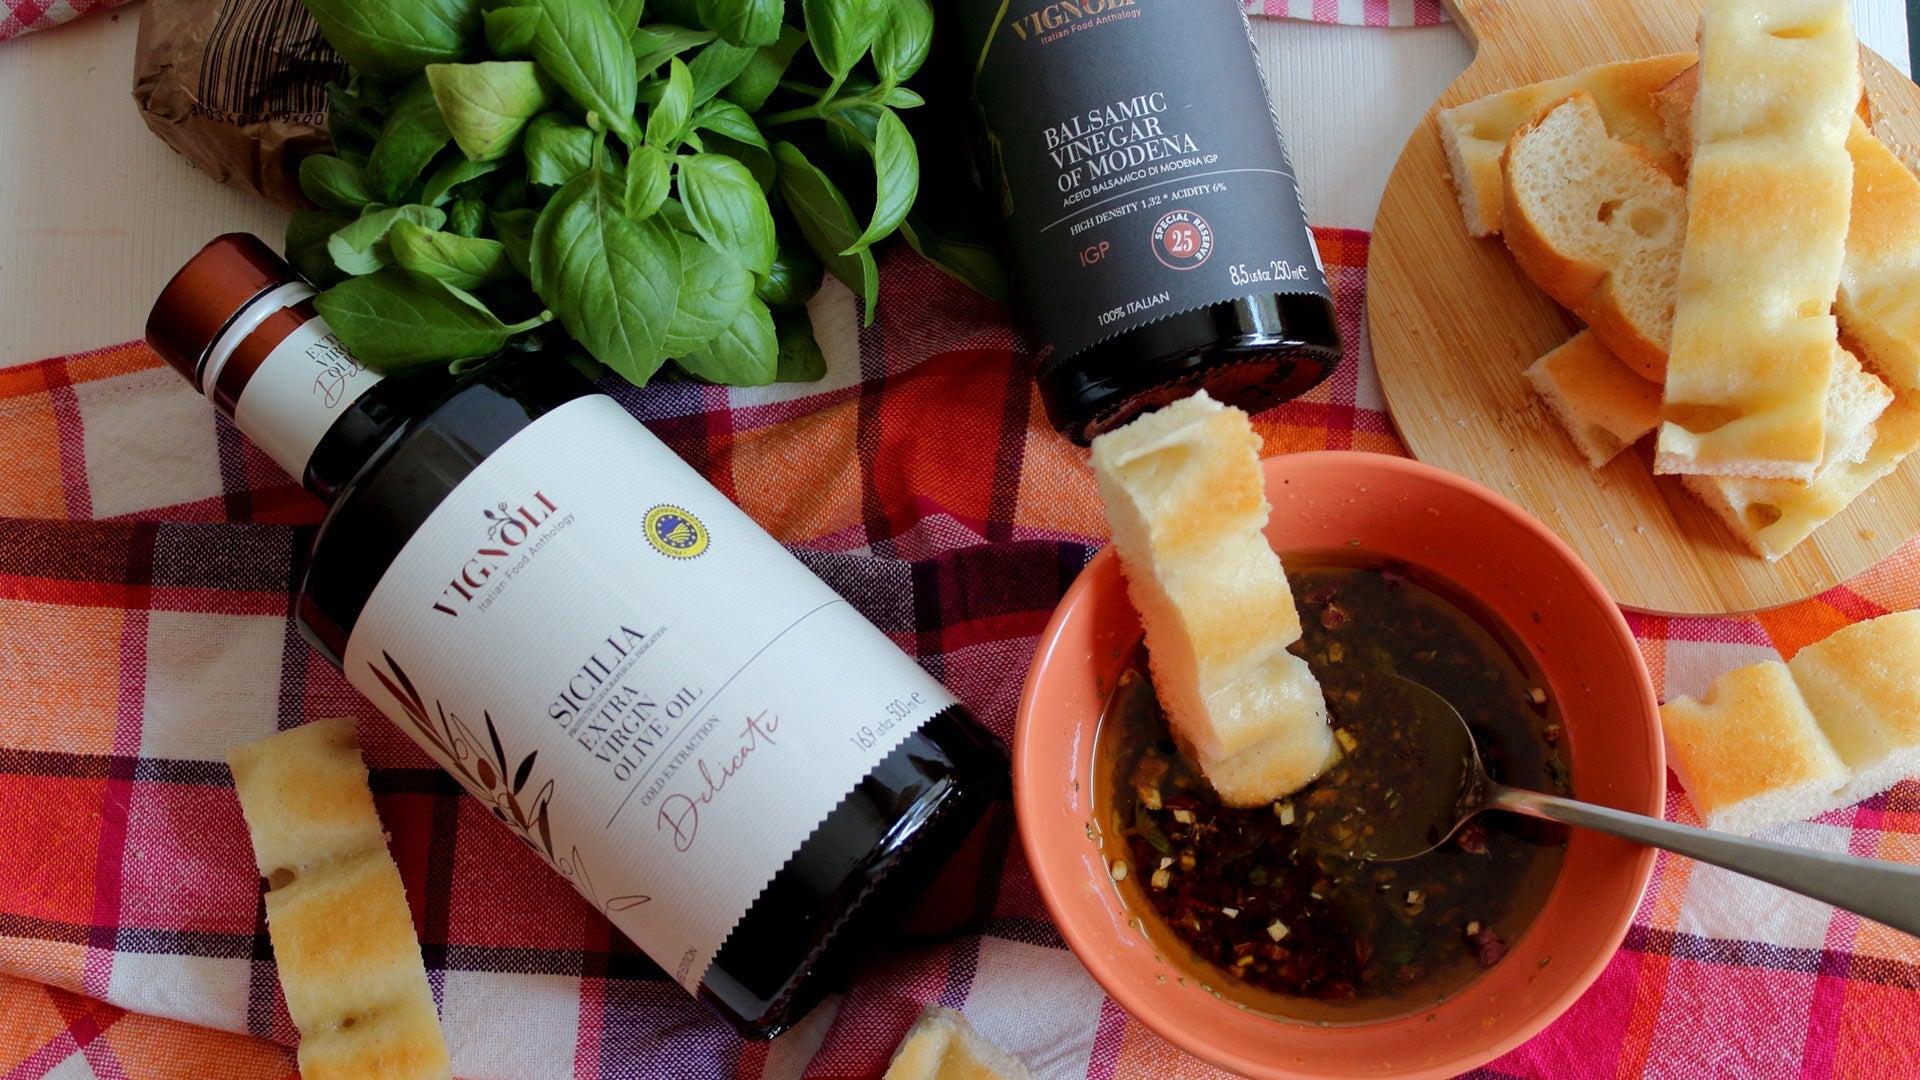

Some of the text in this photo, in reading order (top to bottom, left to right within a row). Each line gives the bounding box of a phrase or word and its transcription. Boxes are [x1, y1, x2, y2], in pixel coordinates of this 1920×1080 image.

[1011, 0, 1136, 41] VIGNO
[1041, 8, 1141, 45] Italian Food Anthology
[1043, 92, 1167, 150] BALSAMIC
[1050, 116, 1164, 170] VINEGAR
[1058, 133, 1200, 193] OF MODENA
[1063, 154, 1219, 207] ACETO BALSAMICO DI MODENA IGP
[1070, 182, 1227, 236] HIGH DENSITY 1,32 ACIDITY 6%
[1080, 241, 1110, 267] IGP
[1155, 213, 1211, 261] SPECIAL RESERVE
[1171, 229, 1193, 252] 25
[1229, 265, 1249, 286] 8,5
[1098, 290, 1170, 326] 100% ITALIAN
[304, 332, 341, 360] EXT
[432, 489, 559, 617] VIGNOLI
[477, 511, 576, 612] Italian Food Anthology
[547, 625, 647, 729] SICILIA
[578, 685, 639, 752] EXTRA
[595, 693, 658, 763] VIRGIN
[613, 686, 704, 781] OLIVE OIL
[641, 713, 720, 806] COLD EXTRACTION
[657, 708, 779, 853] Delicate
